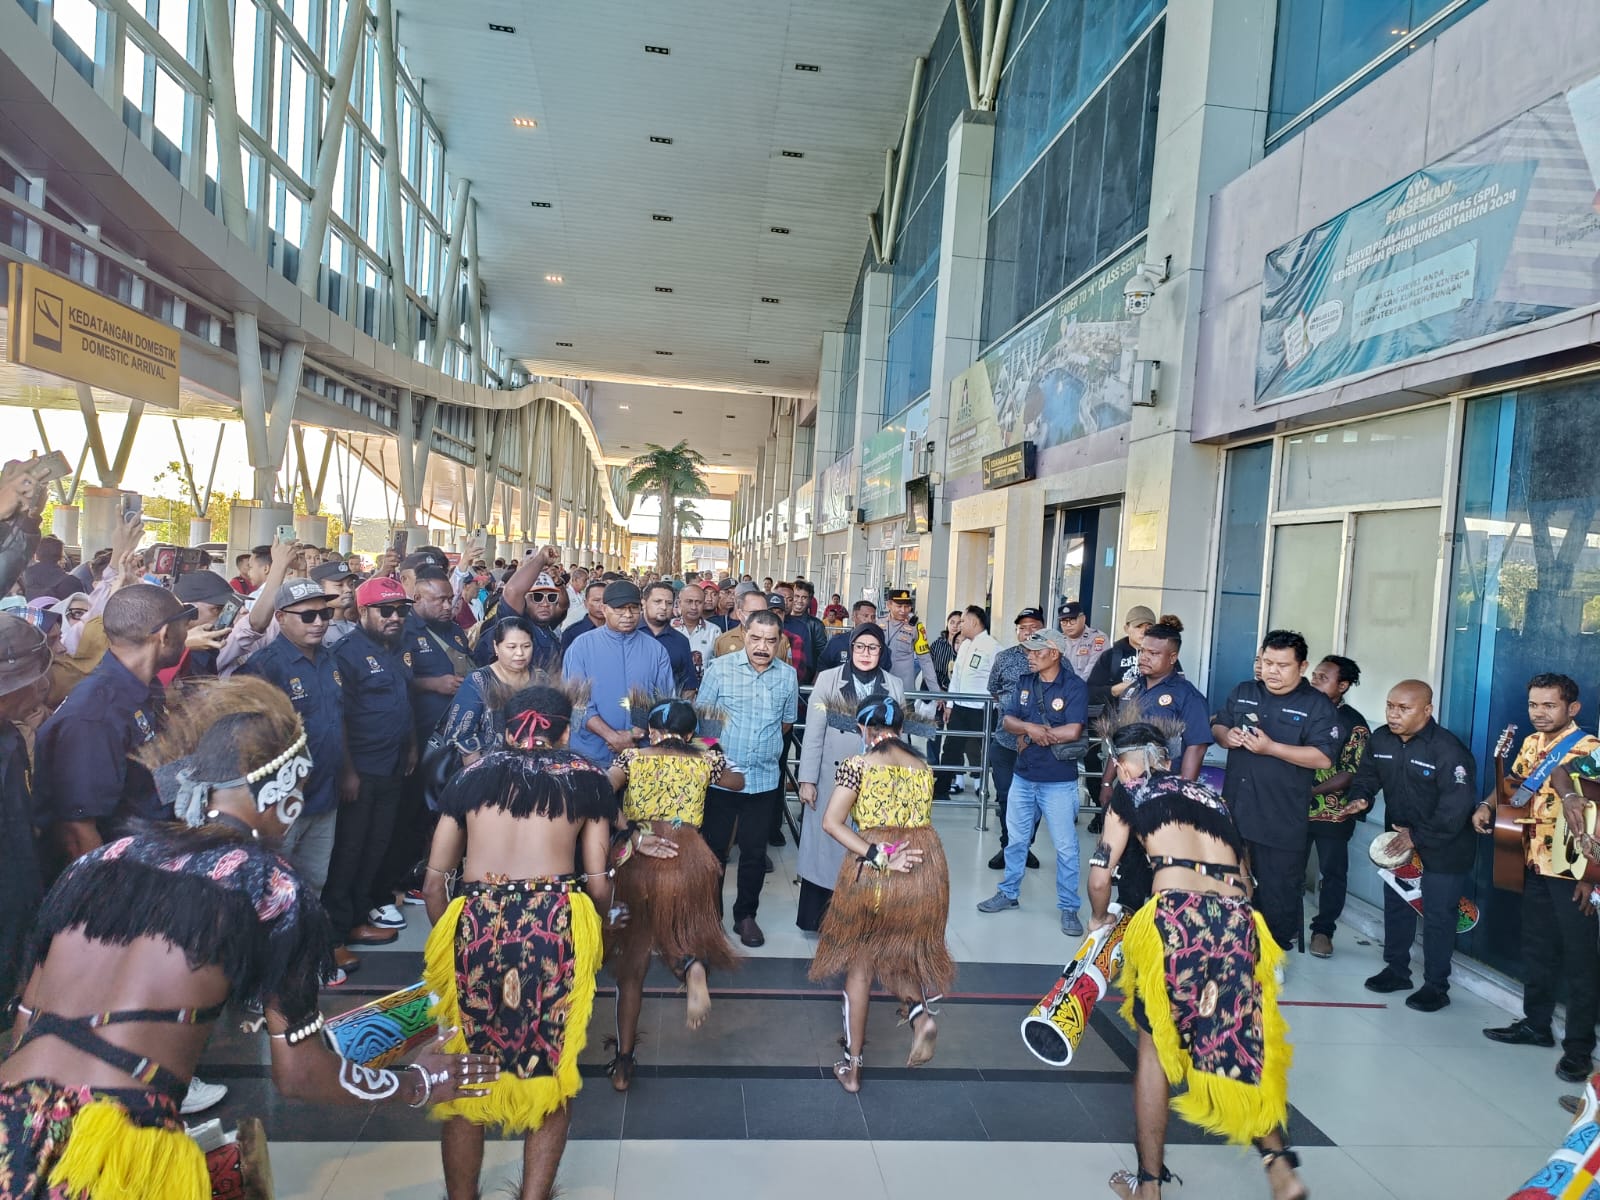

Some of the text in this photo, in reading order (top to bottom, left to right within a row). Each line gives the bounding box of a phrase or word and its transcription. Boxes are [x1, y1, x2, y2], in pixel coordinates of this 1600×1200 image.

[1406, 177, 1430, 199] AYO
[1418, 196, 1472, 232] INTEGRITAS
[1472, 183, 1500, 205] (SPI)
[1385, 218, 1452, 258] PERHUBUNGAN
[1453, 203, 1488, 229] TAHUN
[1488, 189, 1517, 214] 2024
[68, 306, 177, 363] KEDATANGAN DOMESTIK
[82, 337, 166, 380] DOMESTIC ARRIVAL
